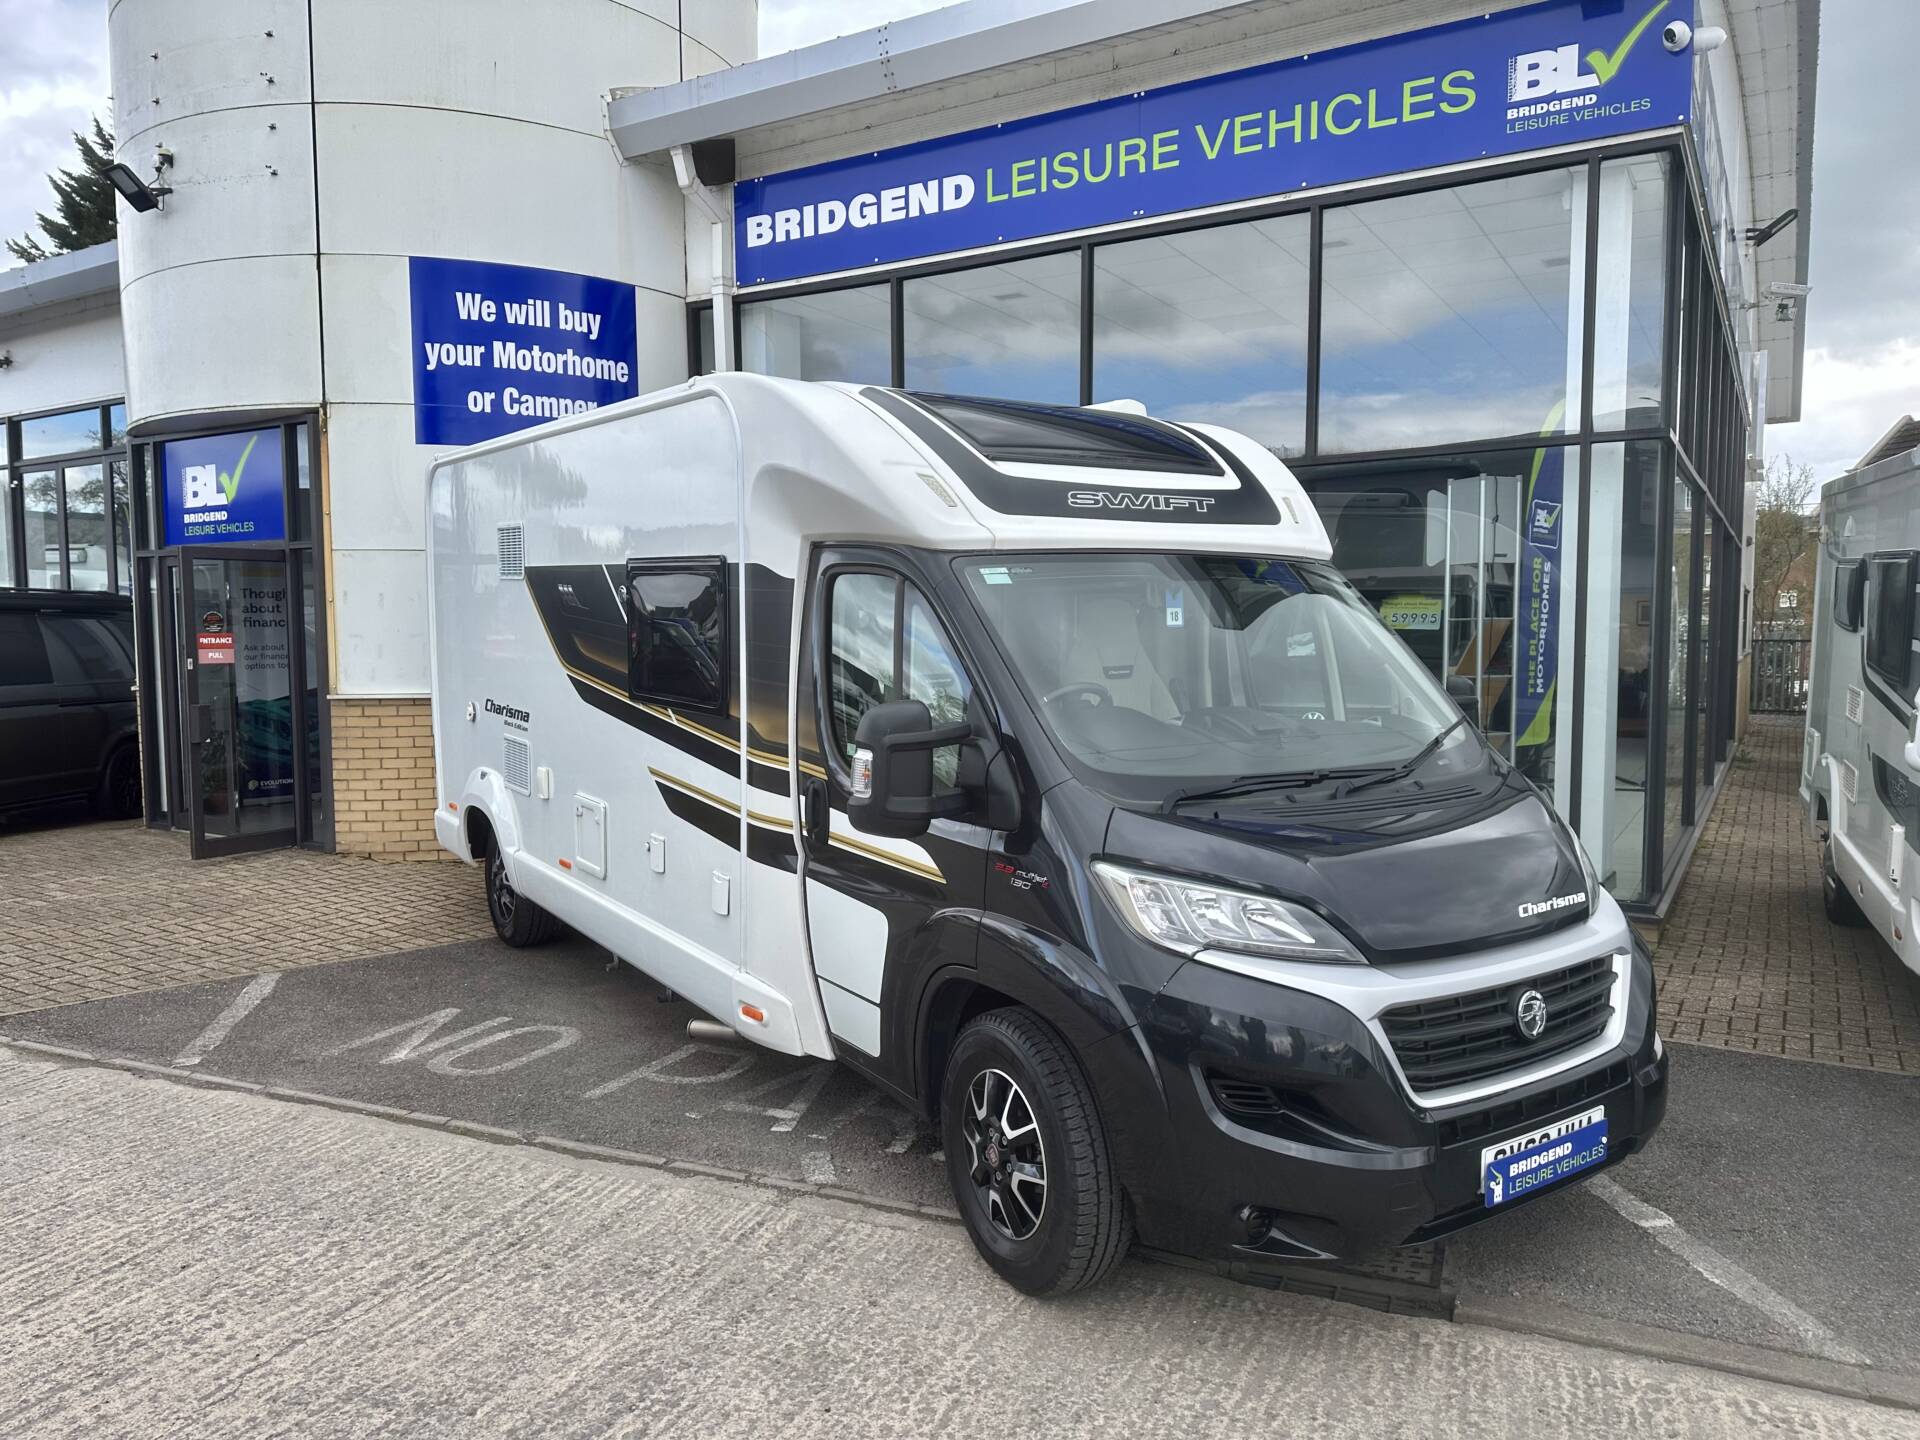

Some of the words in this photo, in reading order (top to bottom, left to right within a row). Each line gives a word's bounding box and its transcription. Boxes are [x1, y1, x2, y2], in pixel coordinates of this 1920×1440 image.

[1506, 94, 1598, 120] BRIDGEND
[1506, 112, 1569, 134] LEISURE
[1573, 98, 1651, 121] VEHICLES
[746, 174, 975, 248] BRIDGEND
[986, 129, 1180, 203] LEISURE
[1194, 69, 1477, 160] VEHICLES
[455, 291, 497, 322] We
[504, 298, 551, 328] will
[558, 302, 602, 340] buy
[424, 342, 485, 371] your
[492, 340, 629, 383] Motorhome
[467, 390, 496, 413] or
[1068, 490, 1215, 513] SWIFT
[183, 511, 228, 524] BRIDGEND
[184, 524, 216, 537] LEISURE
[217, 521, 255, 534] VEHICLES
[1532, 556, 1543, 594] FOR
[242, 603, 282, 614] about
[1391, 612, 1438, 624] 59995
[1529, 597, 1540, 656] PLACE
[1536, 561, 1551, 694] MOTORHOMES
[208, 651, 224, 659] PULL
[243, 644, 258, 652] Ask
[260, 643, 285, 652] about
[243, 653, 258, 661] our
[1527, 660, 1537, 697] THE
[485, 698, 530, 722] Charisma
[1518, 892, 1586, 918] Charisma
[326, 1007, 583, 1076] NO
[1509, 1142, 1573, 1177] BRIDGEND
[1509, 1164, 1554, 1194] LEISURE
[1556, 1143, 1605, 1174] VEHICLES
